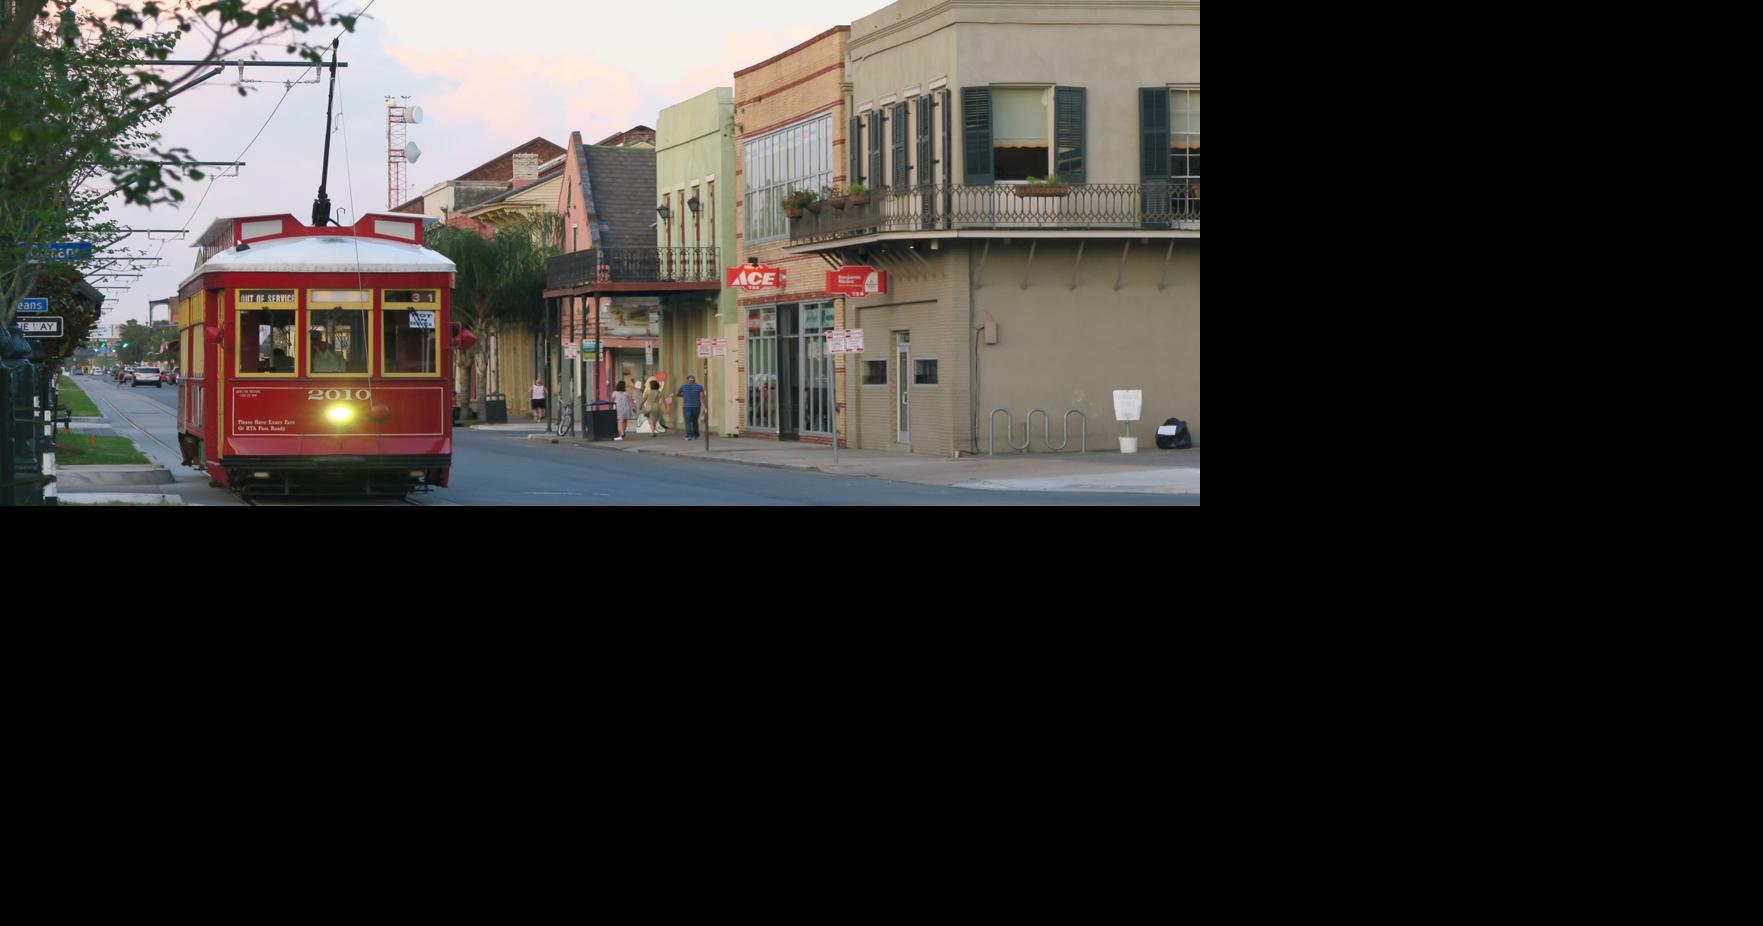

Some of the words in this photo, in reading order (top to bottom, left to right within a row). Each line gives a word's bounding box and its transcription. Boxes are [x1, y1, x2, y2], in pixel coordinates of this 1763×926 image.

[731, 270, 776, 286] ACE
[240, 294, 254, 303] OUT
[256, 294, 265, 303] OF
[267, 294, 295, 303] SERVICE
[17, 302, 42, 310] eans
[308, 389, 370, 400] 2010
